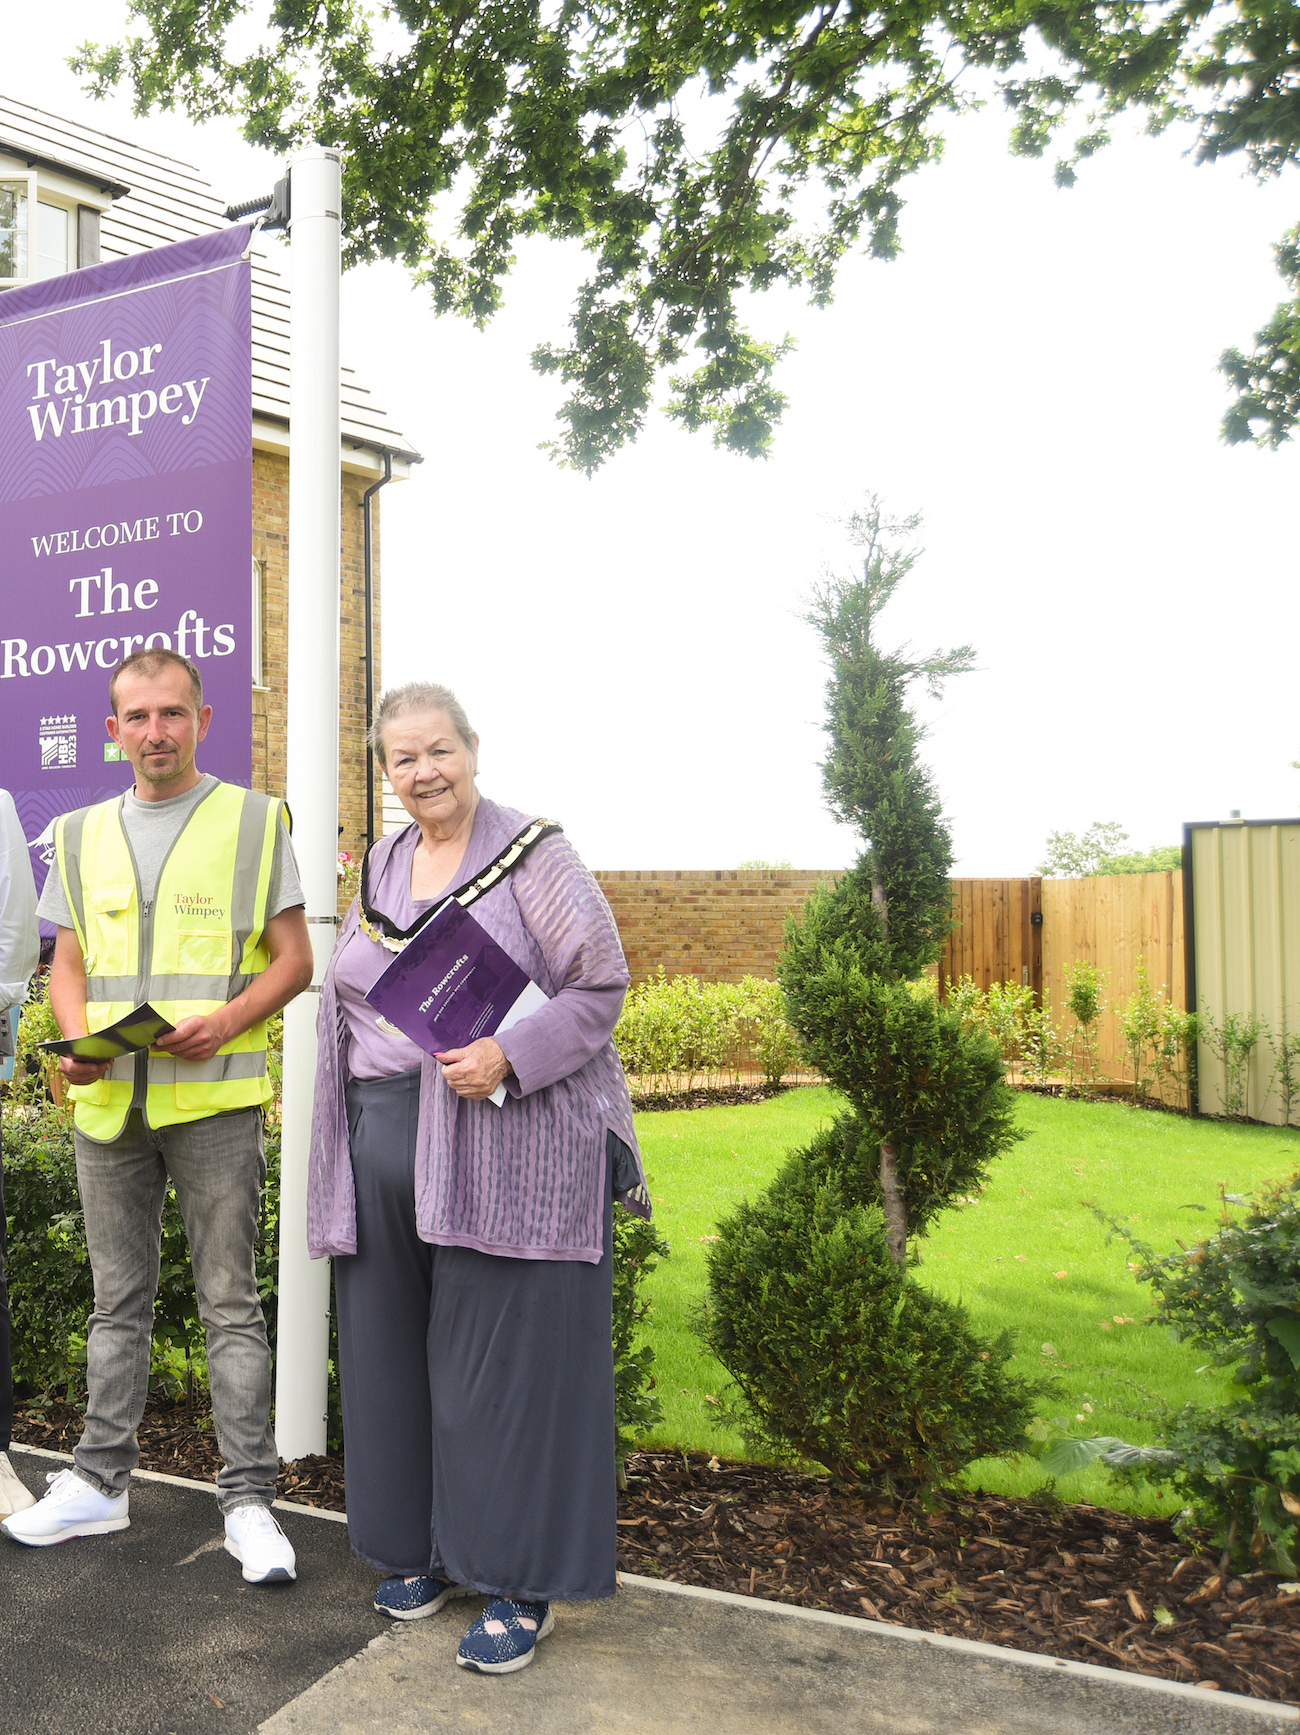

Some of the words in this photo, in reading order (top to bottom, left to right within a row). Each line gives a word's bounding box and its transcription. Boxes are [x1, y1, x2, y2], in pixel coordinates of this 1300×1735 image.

[26, 338, 163, 405] Taylor
[26, 376, 211, 442] Wimpey
[30, 516, 160, 558] WELCOME
[166, 509, 203, 536] TO
[69, 567, 159, 618] The
[58, 735, 69, 765] HBF
[68, 734, 77, 764] 2023
[174, 892, 214, 907] Taylor
[174, 904, 226, 920] Wimpey
[418, 995, 435, 1014] The
[431, 953, 470, 997] Rowcrofts
